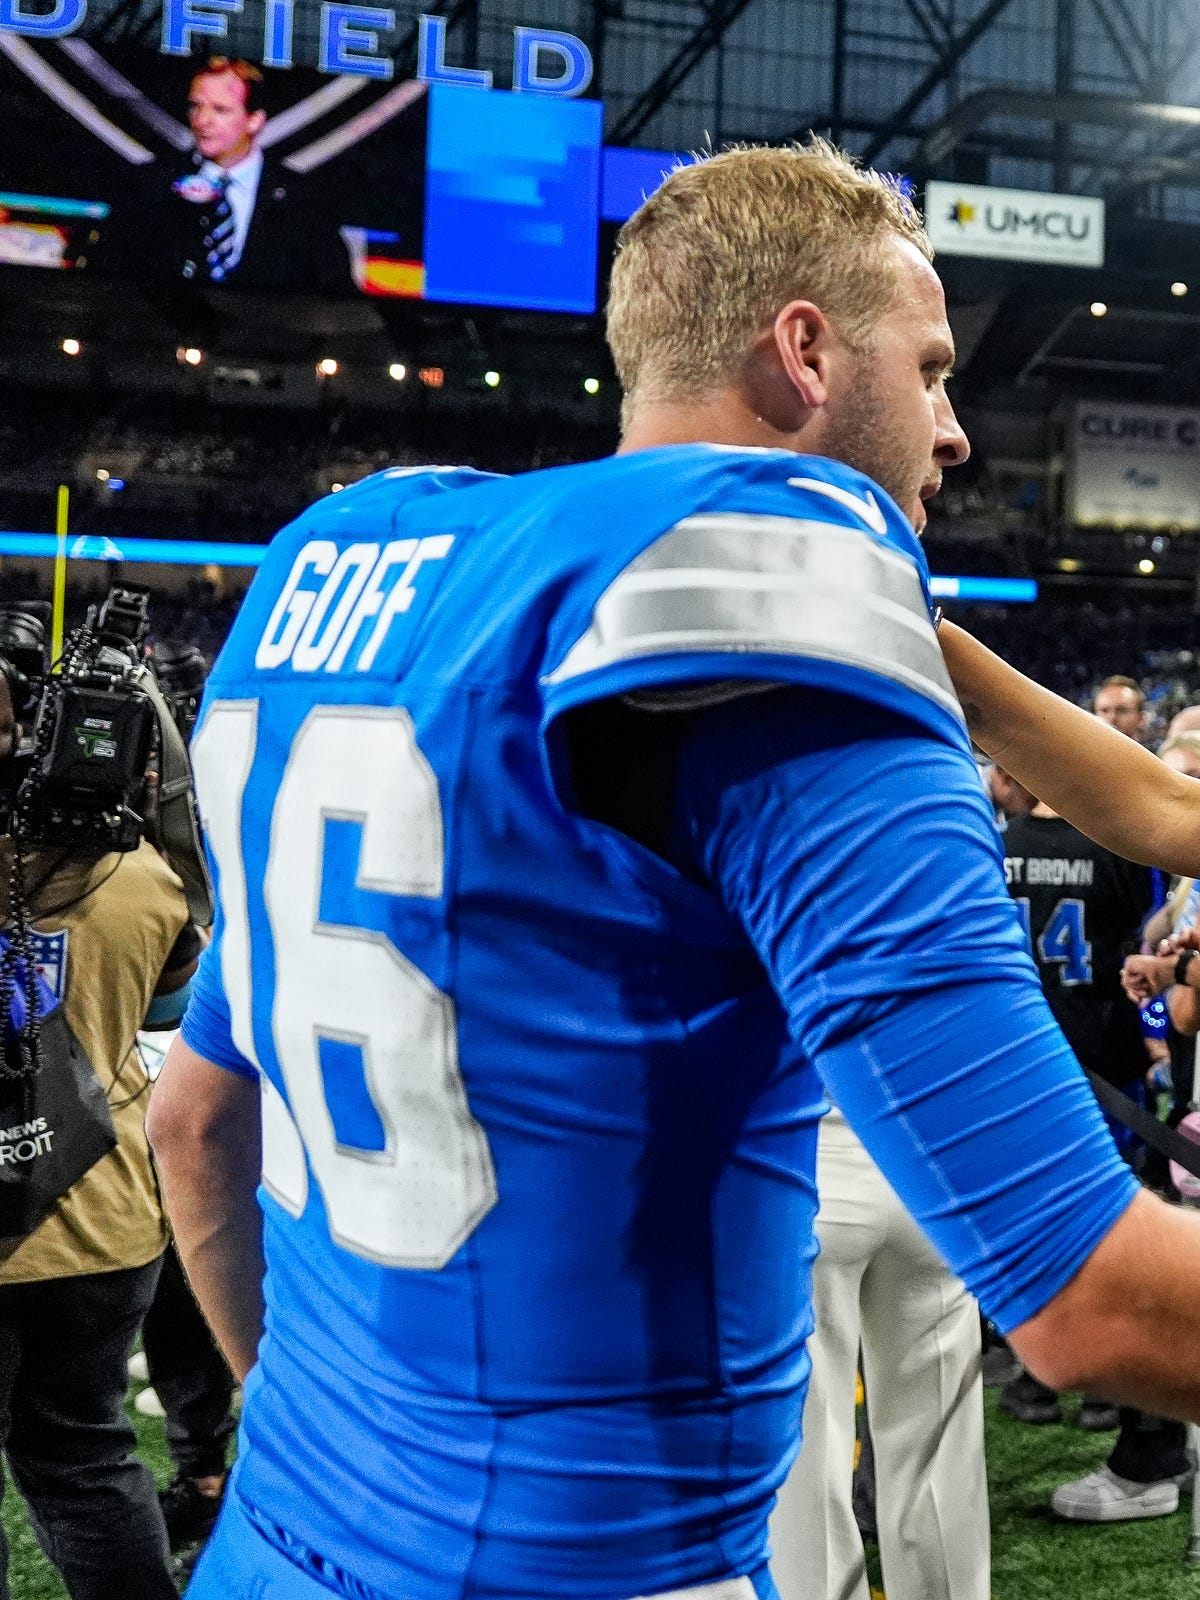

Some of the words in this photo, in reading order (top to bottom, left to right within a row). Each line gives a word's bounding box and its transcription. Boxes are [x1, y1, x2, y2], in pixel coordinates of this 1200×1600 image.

[160, 0, 595, 98] FIELD
[984, 203, 1090, 241] UMCU
[255, 533, 455, 673] GOFF
[1026, 857, 1094, 885] BROWN
[190, 698, 499, 1272] 16
[0, 1130, 55, 1166] ROIT
